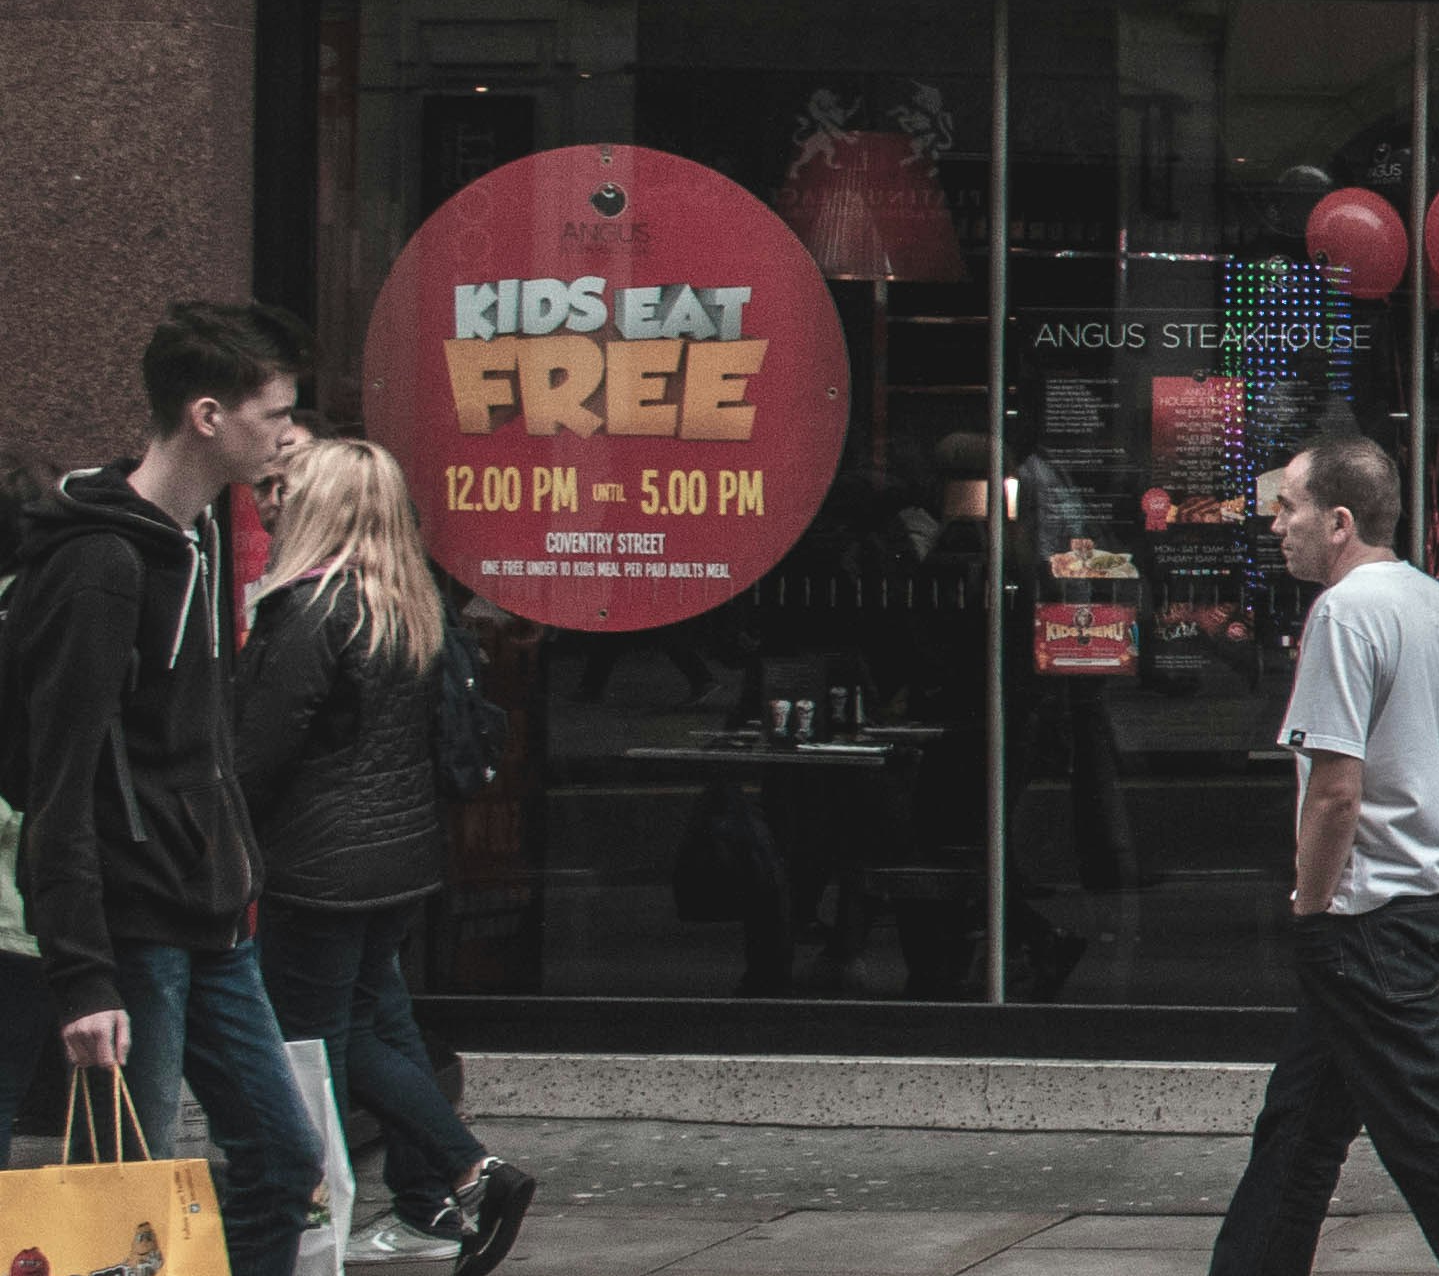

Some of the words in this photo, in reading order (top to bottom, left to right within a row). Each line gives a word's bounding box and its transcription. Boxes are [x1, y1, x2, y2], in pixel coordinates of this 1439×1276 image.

[454, 275, 608, 342] KIDS
[614, 283, 753, 341] EAT
[1034, 323, 1147, 349] ANGUS
[1161, 323, 1373, 350] STEAKHOUSE
[442, 335, 770, 442] FREE
[445, 465, 522, 512] 12.00
[532, 466, 579, 513] PM
[592, 483, 627, 502] UNTIL
[640, 469, 707, 515] 5.00
[718, 470, 765, 516] PM
[545, 532, 614, 554] COVENTRY
[617, 533, 666, 555] STREET
[503, 561, 525, 575] FREE
